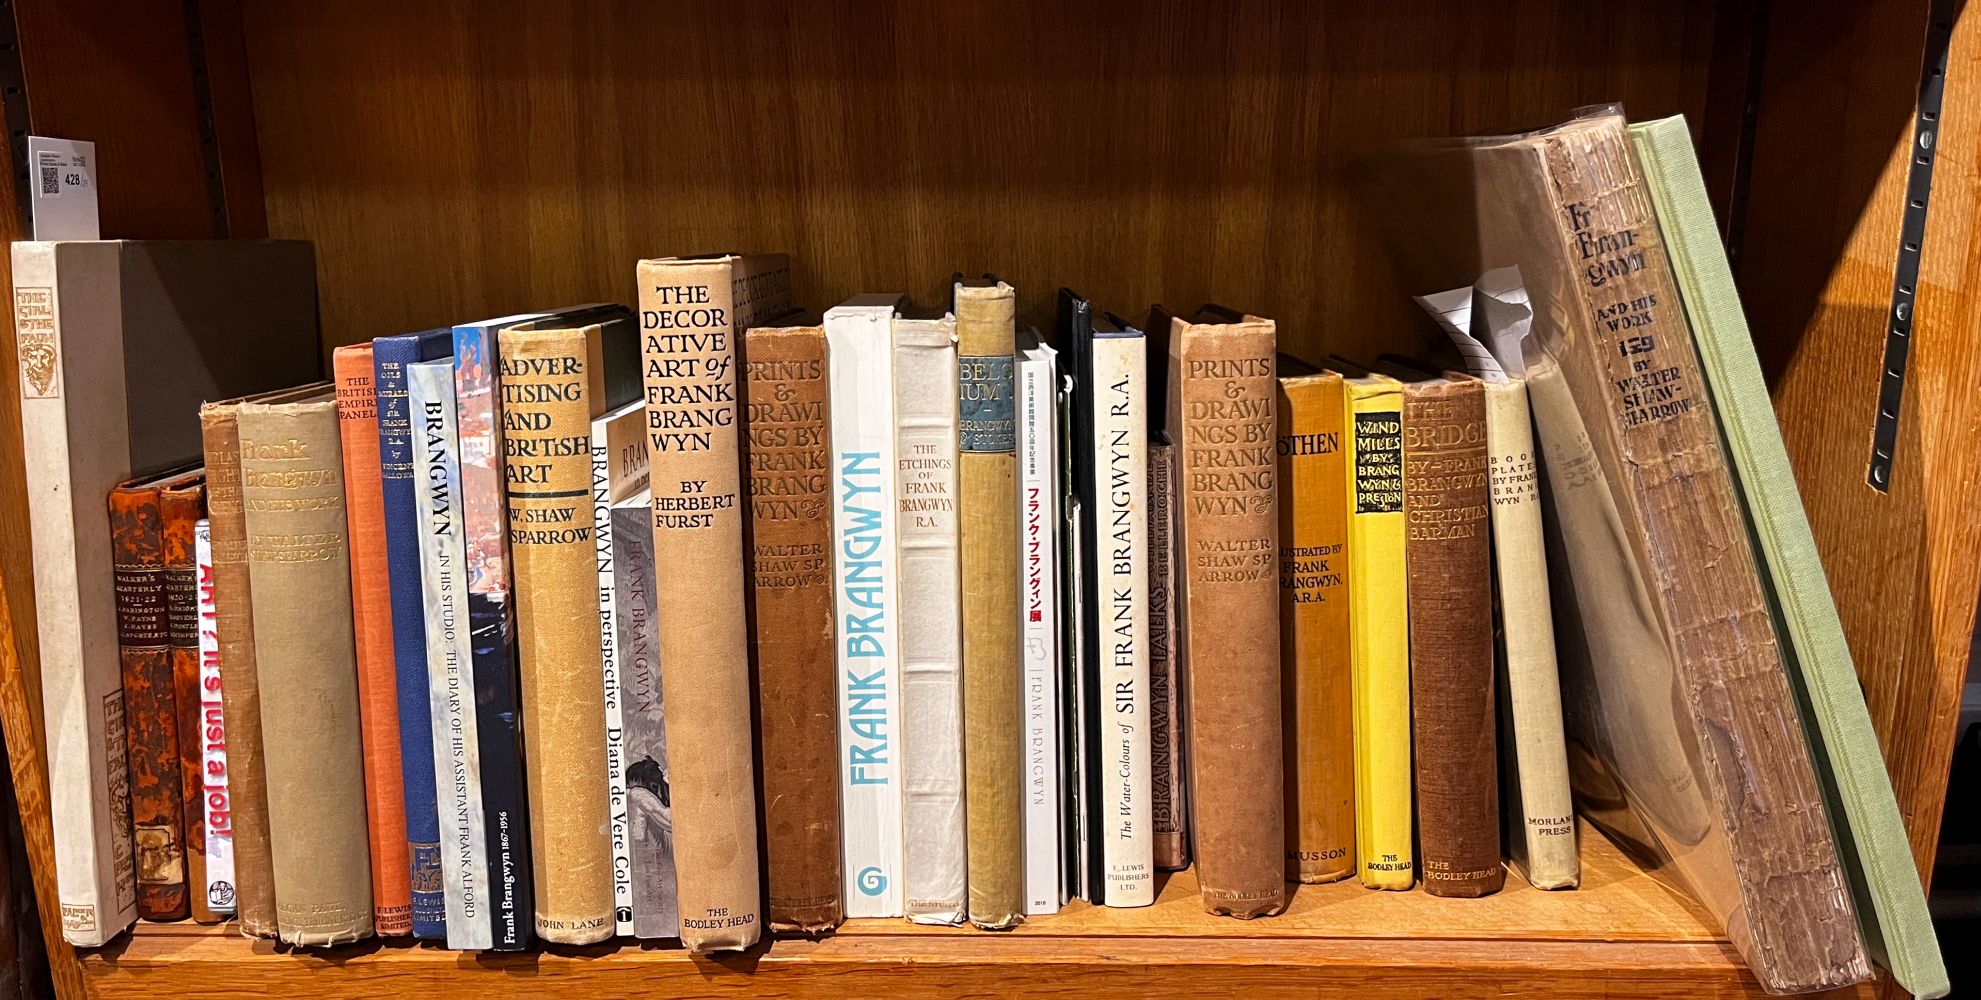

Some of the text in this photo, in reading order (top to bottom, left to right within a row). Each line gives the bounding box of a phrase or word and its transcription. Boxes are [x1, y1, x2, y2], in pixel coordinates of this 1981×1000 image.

[65, 173, 81, 186] 428
[656, 285, 710, 304] THE
[643, 308, 728, 329] DECOR
[646, 333, 727, 354] ATIVE
[501, 356, 583, 376] ADVER-
[646, 355, 731, 381] ART of
[741, 360, 821, 381] PRINTS
[1188, 357, 1271, 379] PRINTS
[1632, 359, 1652, 372] BY
[346, 377, 369, 386] THE
[381, 371, 401, 379] OILS
[502, 383, 582, 405] TISING
[647, 383, 735, 405] FRANK
[774, 383, 796, 401] &
[1224, 380, 1246, 398] &
[649, 407, 733, 429] BRANG
[743, 401, 822, 423] DRAWI
[1190, 399, 1271, 420] DRAWI
[1406, 402, 1454, 420] THE
[504, 411, 552, 431] AND
[1358, 421, 1399, 434] WIND
[651, 432, 711, 452] WYN
[744, 426, 823, 447] NGS BY
[973, 433, 1015, 445] STOKES
[1191, 423, 1272, 444] NGS BY
[1405, 421, 1487, 448] BRIDGE
[506, 435, 591, 457] BRITISH
[914, 444, 937, 454] THE
[1358, 437, 1400, 450] MILLS
[746, 450, 825, 473] FRANK
[899, 459, 952, 470] ETCHINGS
[1191, 449, 1273, 468] FRANK
[1372, 453, 1388, 463] BY
[507, 464, 553, 484] ART
[918, 472, 933, 480] OF
[1358, 464, 1400, 477] BRANG
[680, 480, 707, 493] BY
[749, 474, 826, 496] BRANG
[905, 483, 946, 494] FRANK
[1192, 472, 1273, 492] BRANG
[1358, 478, 1401, 490] WYN &
[1493, 476, 1507, 486] BY
[655, 494, 735, 511] HERBERT
[899, 498, 953, 512] BRANGWYN
[1194, 496, 1248, 516] WYN
[1359, 493, 1401, 507] PRESTON
[1407, 495, 1441, 508] AND
[1494, 497, 1520, 506] WYN
[509, 507, 577, 523] W. SHAW
[591, 446, 614, 573] BRANGWYN
[752, 498, 798, 520] WYN
[1409, 506, 1488, 523] CHRISTIAN
[655, 514, 714, 528] FURST
[916, 516, 938, 528] R.A.
[1157, 459, 1168, 577] BELLEROCHE
[511, 526, 592, 544] SPARROW
[1409, 524, 1476, 541] BARMAN
[753, 543, 823, 557] WALTER
[1198, 538, 1271, 552] WALTER
[1332, 543, 1342, 553] BY
[1027, 487, 1042, 622] フランク・ブラングィン展
[1198, 553, 1272, 568] SHAW SP
[752, 559, 824, 573] SHAW SP
[1283, 559, 1330, 573] FRANK
[117, 573, 156, 583] WALKER'S
[754, 574, 811, 588] ARROW
[1199, 570, 1260, 583] ARROW
[600, 586, 610, 602] in
[1110, 374, 1134, 840] The Water-Colours of SIR FRANK BRANGWYN R.A.
[629, 541, 652, 712] FRANK BRANGWYN
[840, 452, 888, 786] FRANK BRANGWYN
[424, 401, 476, 918] BRANGWYN IN HIS STUDIO: THE DIARY OF HIS ASSISTANT FRANK ALFORD
[599, 608, 621, 710] perspective
[1149, 587, 1169, 823] BRANGWYN TALKS
[1031, 676, 1045, 806] FRANK BRANGWYN
[607, 727, 624, 780] Diana
[206, 760, 224, 776] a
[610, 783, 623, 806] de
[202, 785, 233, 836] job!
[612, 812, 627, 851] Vere
[1538, 826, 1572, 836] PRESS
[1288, 847, 1347, 861] MUSSON
[1122, 863, 1145, 872] LEWIS
[1368, 861, 1412, 871] BODLEY HEAD
[1427, 860, 1450, 869] THE
[498, 811, 515, 945] Frank Brangwyn 1867-1956
[614, 855, 631, 894] Cole
[1107, 872, 1150, 882] PUBLISHERS
[1427, 868, 1497, 882] BODLEY HEAD
[384, 904, 412, 914] LEWIS
[707, 907, 729, 917] THE
[537, 918, 565, 930] JOHN
[571, 916, 604, 929] LANE
[684, 913, 755, 929] BODLEY HEAD
